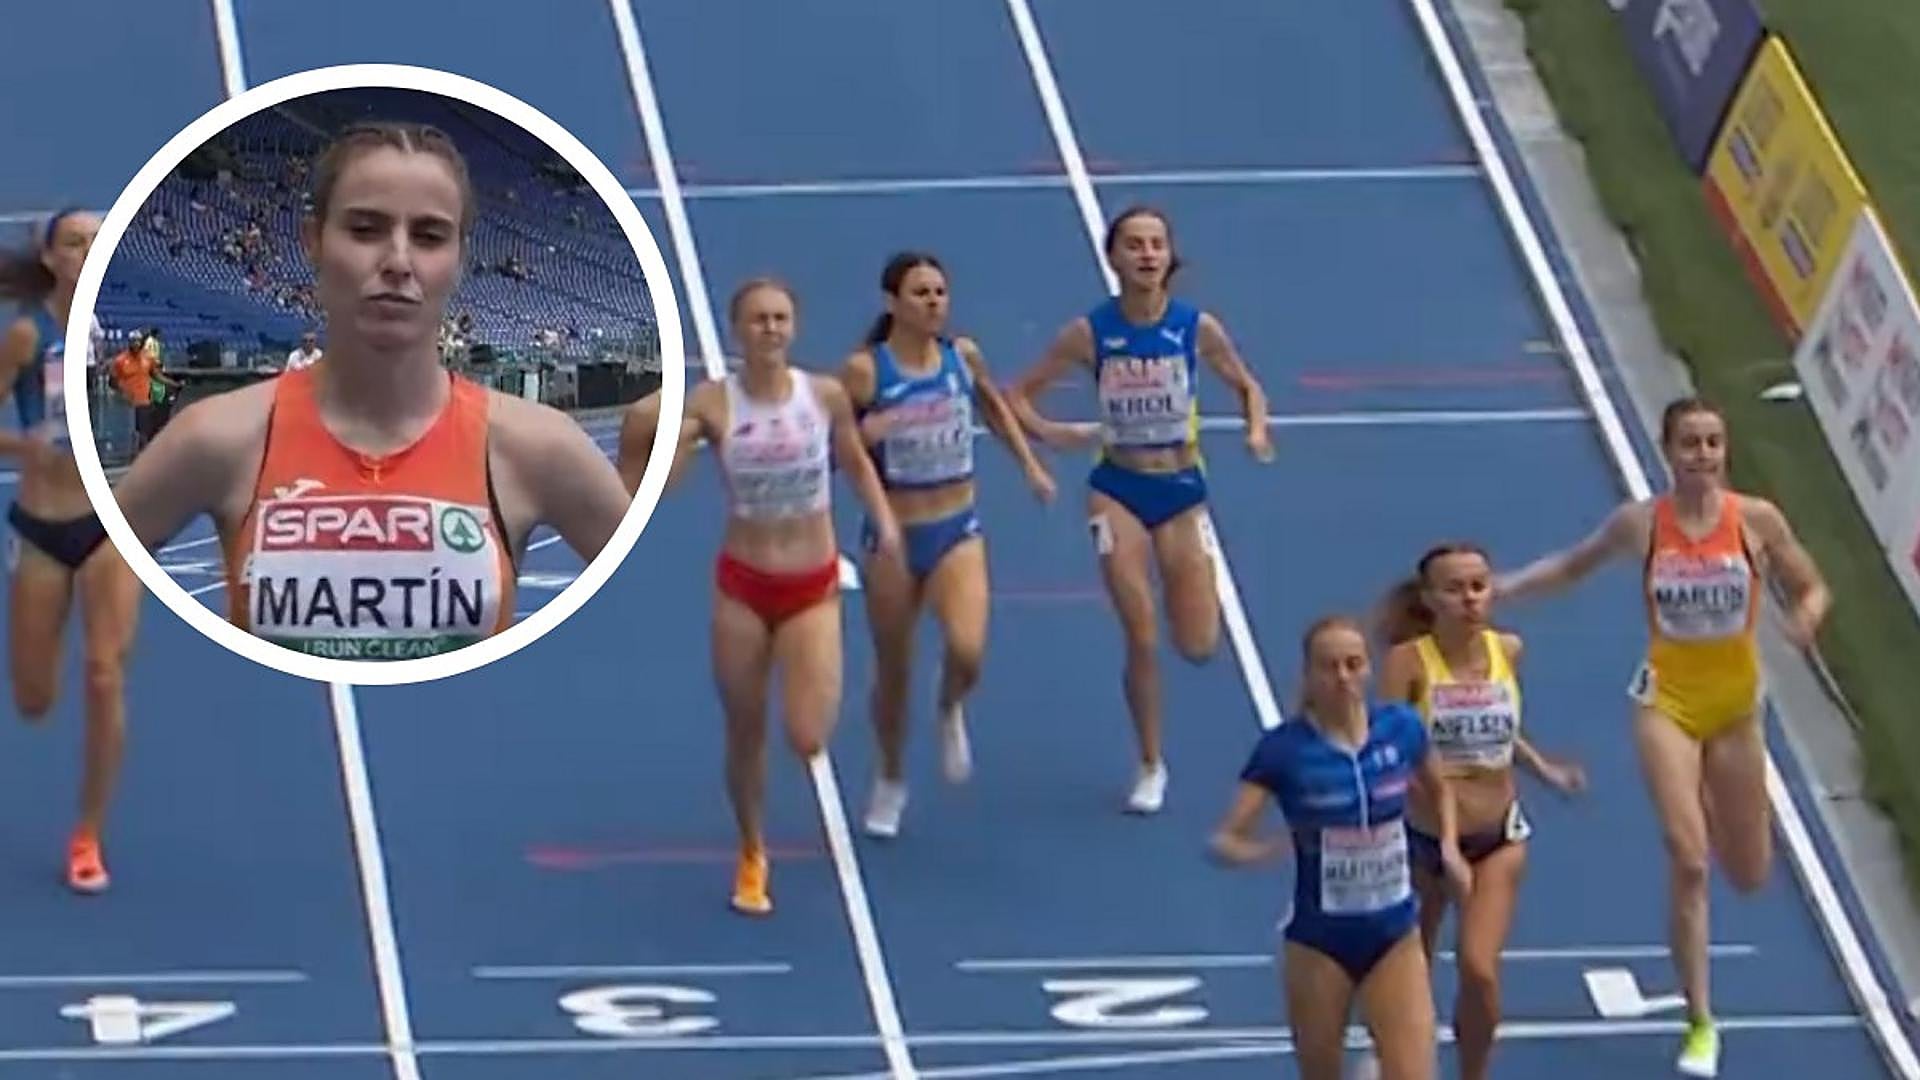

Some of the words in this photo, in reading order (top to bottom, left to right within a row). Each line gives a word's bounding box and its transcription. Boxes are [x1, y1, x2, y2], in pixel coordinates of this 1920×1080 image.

[266, 506, 430, 545] SPAR
[256, 567, 483, 630] MARTÍN
[313, 640, 361, 657] RUN
[365, 639, 438, 657] CLEAN
[59, 996, 236, 1043] 4
[557, 985, 718, 1035] 3
[1041, 977, 1209, 1028] 2
